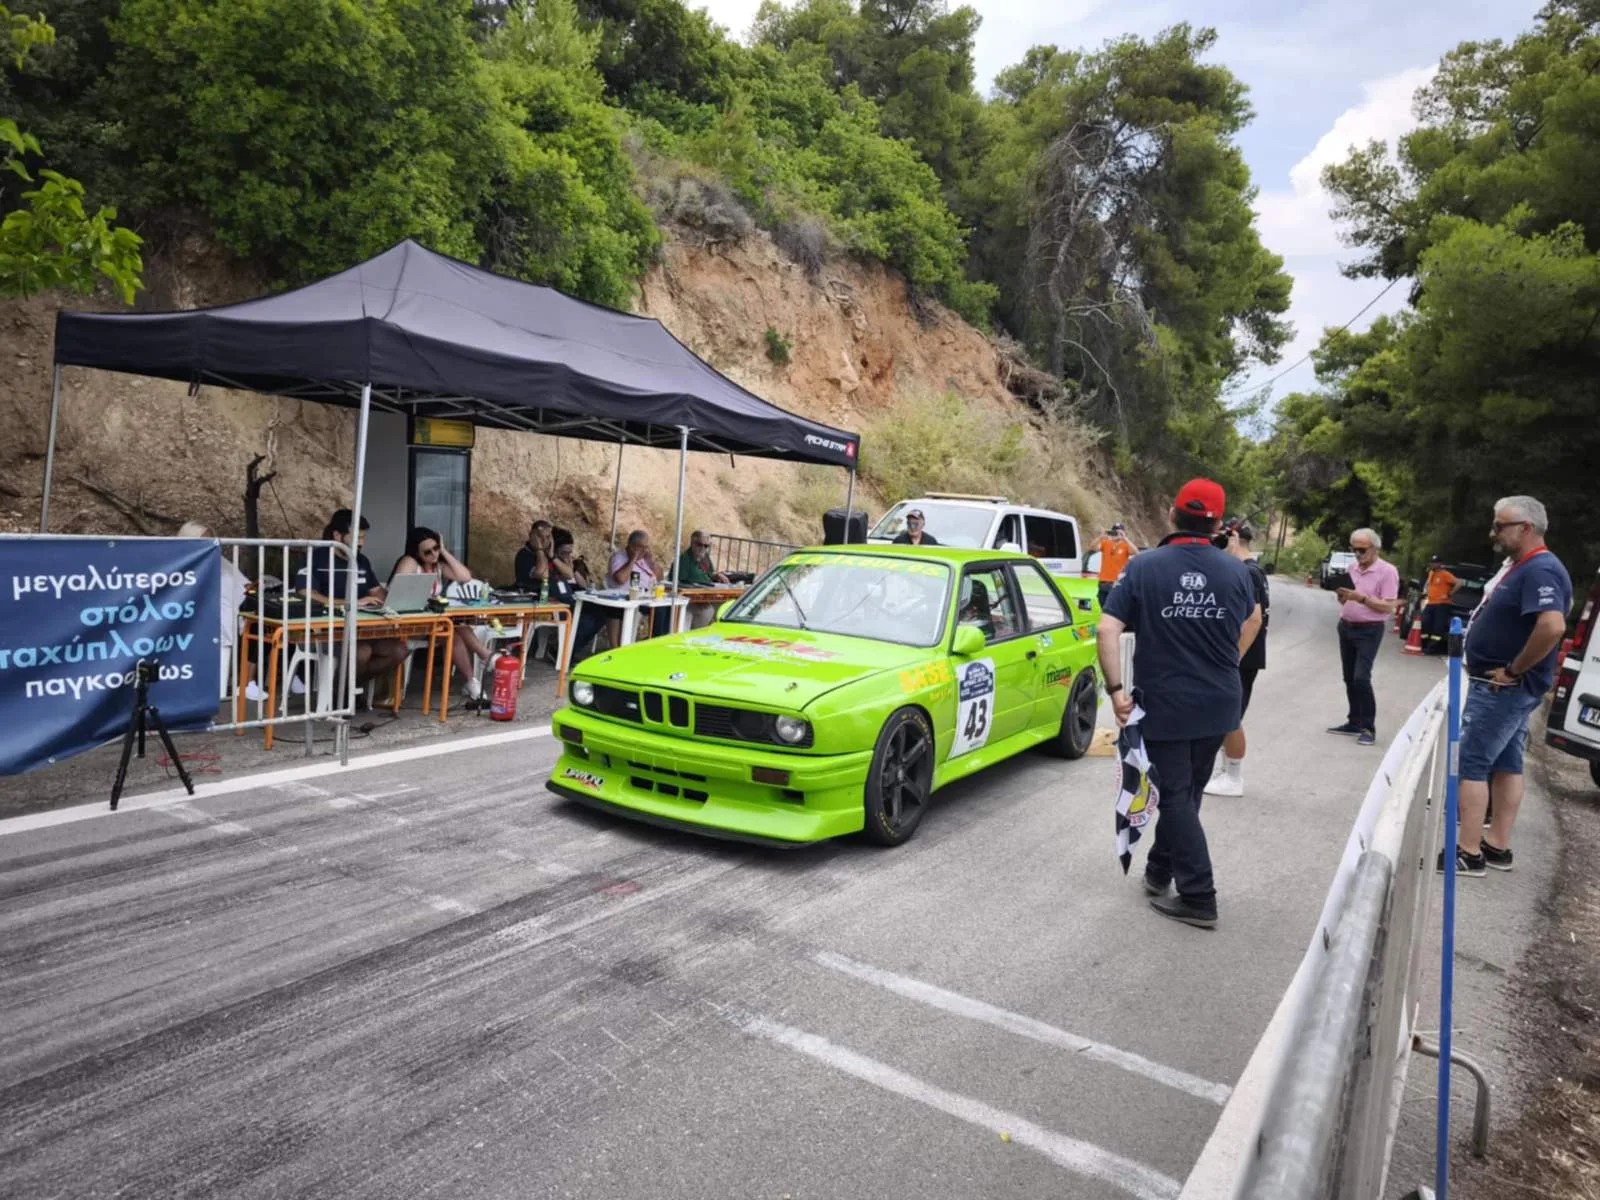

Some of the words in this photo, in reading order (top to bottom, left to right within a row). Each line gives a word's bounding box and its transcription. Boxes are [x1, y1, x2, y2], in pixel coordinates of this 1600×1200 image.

[12, 564, 197, 600] μεγαλύτερος
[1182, 575, 1204, 587] FIA
[80, 594, 195, 626] στόλος
[1161, 606, 1227, 619] GREECE
[1173, 591, 1217, 606] BAJA
[0, 630, 195, 670] ταχύπλοων
[25, 658, 194, 700] παγκοσως
[963, 698, 988, 741] 43
